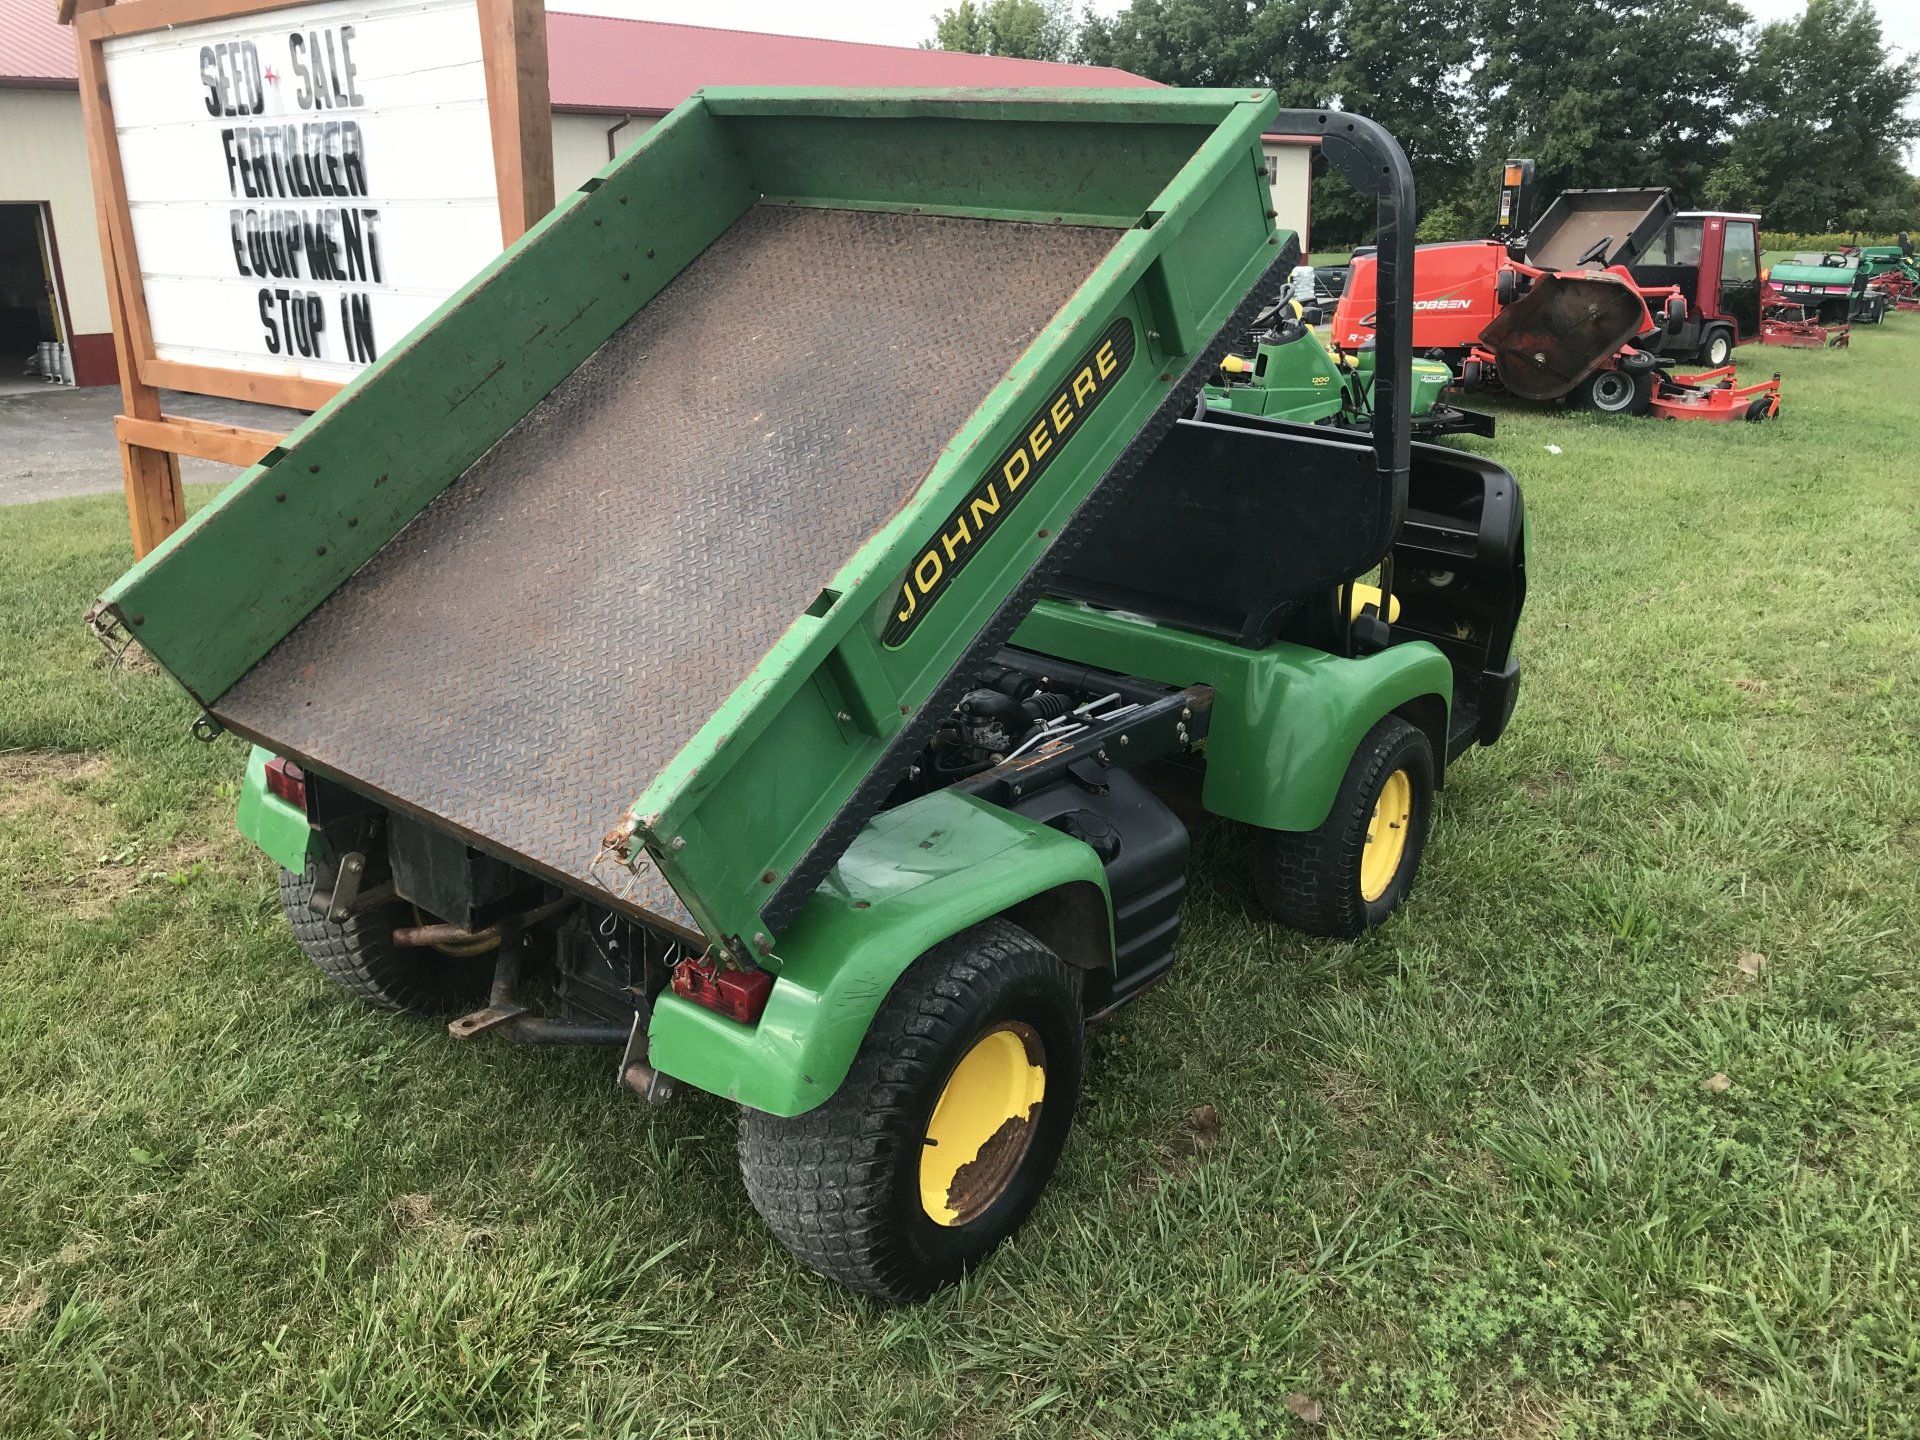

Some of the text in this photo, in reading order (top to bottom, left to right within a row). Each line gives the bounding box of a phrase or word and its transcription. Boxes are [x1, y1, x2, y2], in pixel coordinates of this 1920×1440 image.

[200, 25, 364, 117] SEED SALE
[221, 120, 369, 198] FERTILIZER
[230, 208, 382, 284] EQUIPMENT
[258, 287, 376, 363] STOP IN
[898, 339, 1118, 622] JOHN DEERE
